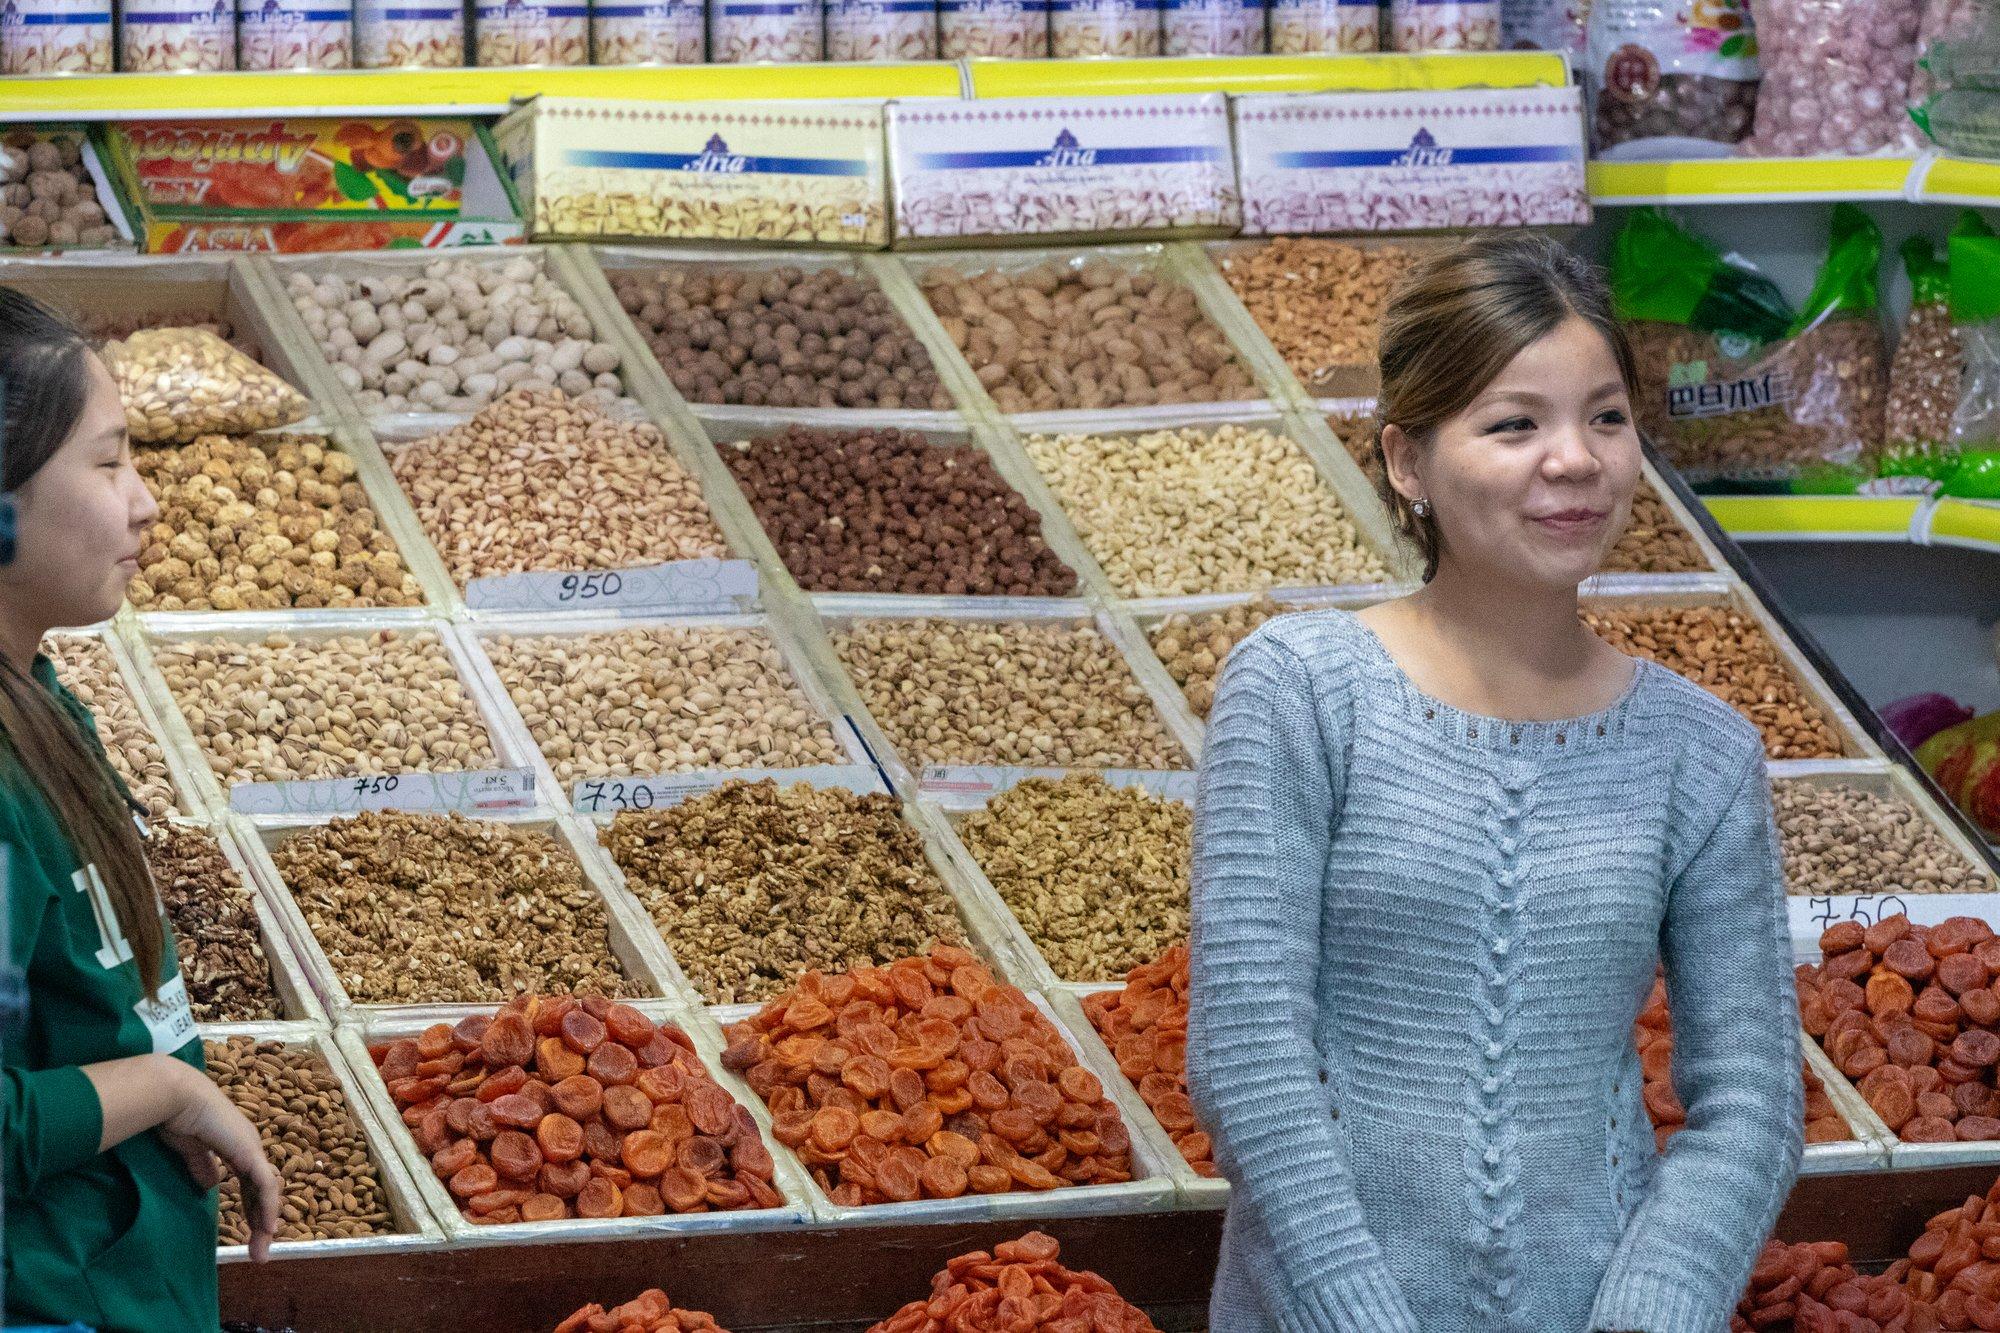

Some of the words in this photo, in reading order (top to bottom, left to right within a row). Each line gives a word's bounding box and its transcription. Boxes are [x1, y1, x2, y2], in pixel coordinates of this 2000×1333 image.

[682, 149, 747, 174] Aria
[1036, 145, 1097, 168] Aria
[1391, 145, 1454, 168] Aria
[559, 571, 623, 602] 950
[353, 775, 400, 797] 750
[581, 782, 654, 813] 730
[1809, 895, 1907, 930] 750
